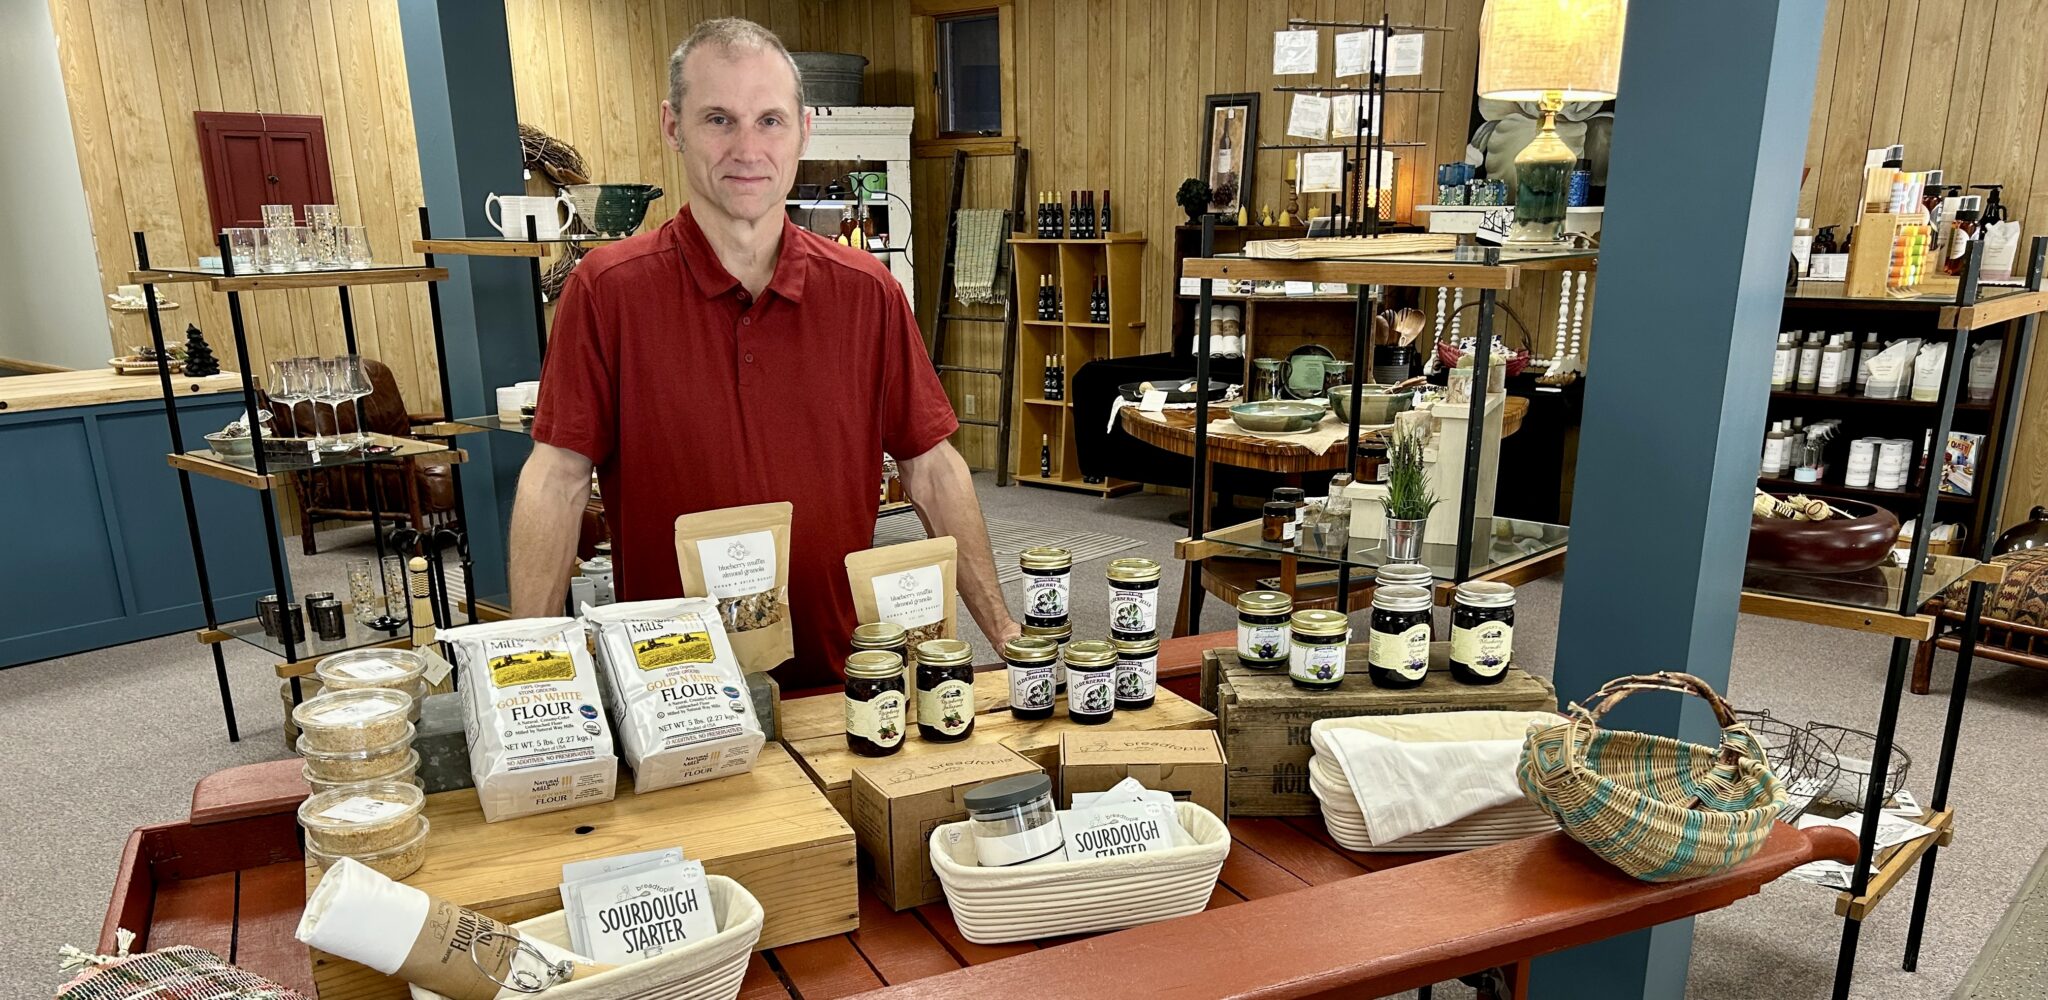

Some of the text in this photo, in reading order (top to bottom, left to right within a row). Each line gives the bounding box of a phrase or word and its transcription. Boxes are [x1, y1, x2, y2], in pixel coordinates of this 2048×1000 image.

[719, 562, 746, 572] blueberry
[722, 567, 764, 578] almond granola
[647, 678, 676, 692] GOLD
[690, 675, 723, 684] WHITE
[1017, 674, 1048, 685] ELDERBERRY
[1074, 679, 1107, 689] ELDERBERRY
[661, 683, 718, 702] FLOUR
[497, 695, 530, 709] GOLD
[544, 692, 583, 702] WHITE
[512, 701, 574, 721] FLOUR
[707, 727, 742, 737] PRESERVATIVES
[1124, 740, 1206, 751] breadtopia
[556, 750, 595, 759] PRESERVATIVES
[928, 757, 1012, 771] breadtopia
[684, 768, 712, 777] FLOUR
[536, 795, 567, 804] FLOUR
[1105, 814, 1139, 822] breadtopia
[1075, 820, 1160, 852] SOURDOUGH
[636, 884, 674, 893] breadtopia
[599, 888, 699, 934] SOURDOUGH
[450, 916, 476, 952] FLOUR
[623, 918, 687, 954] STARTER
